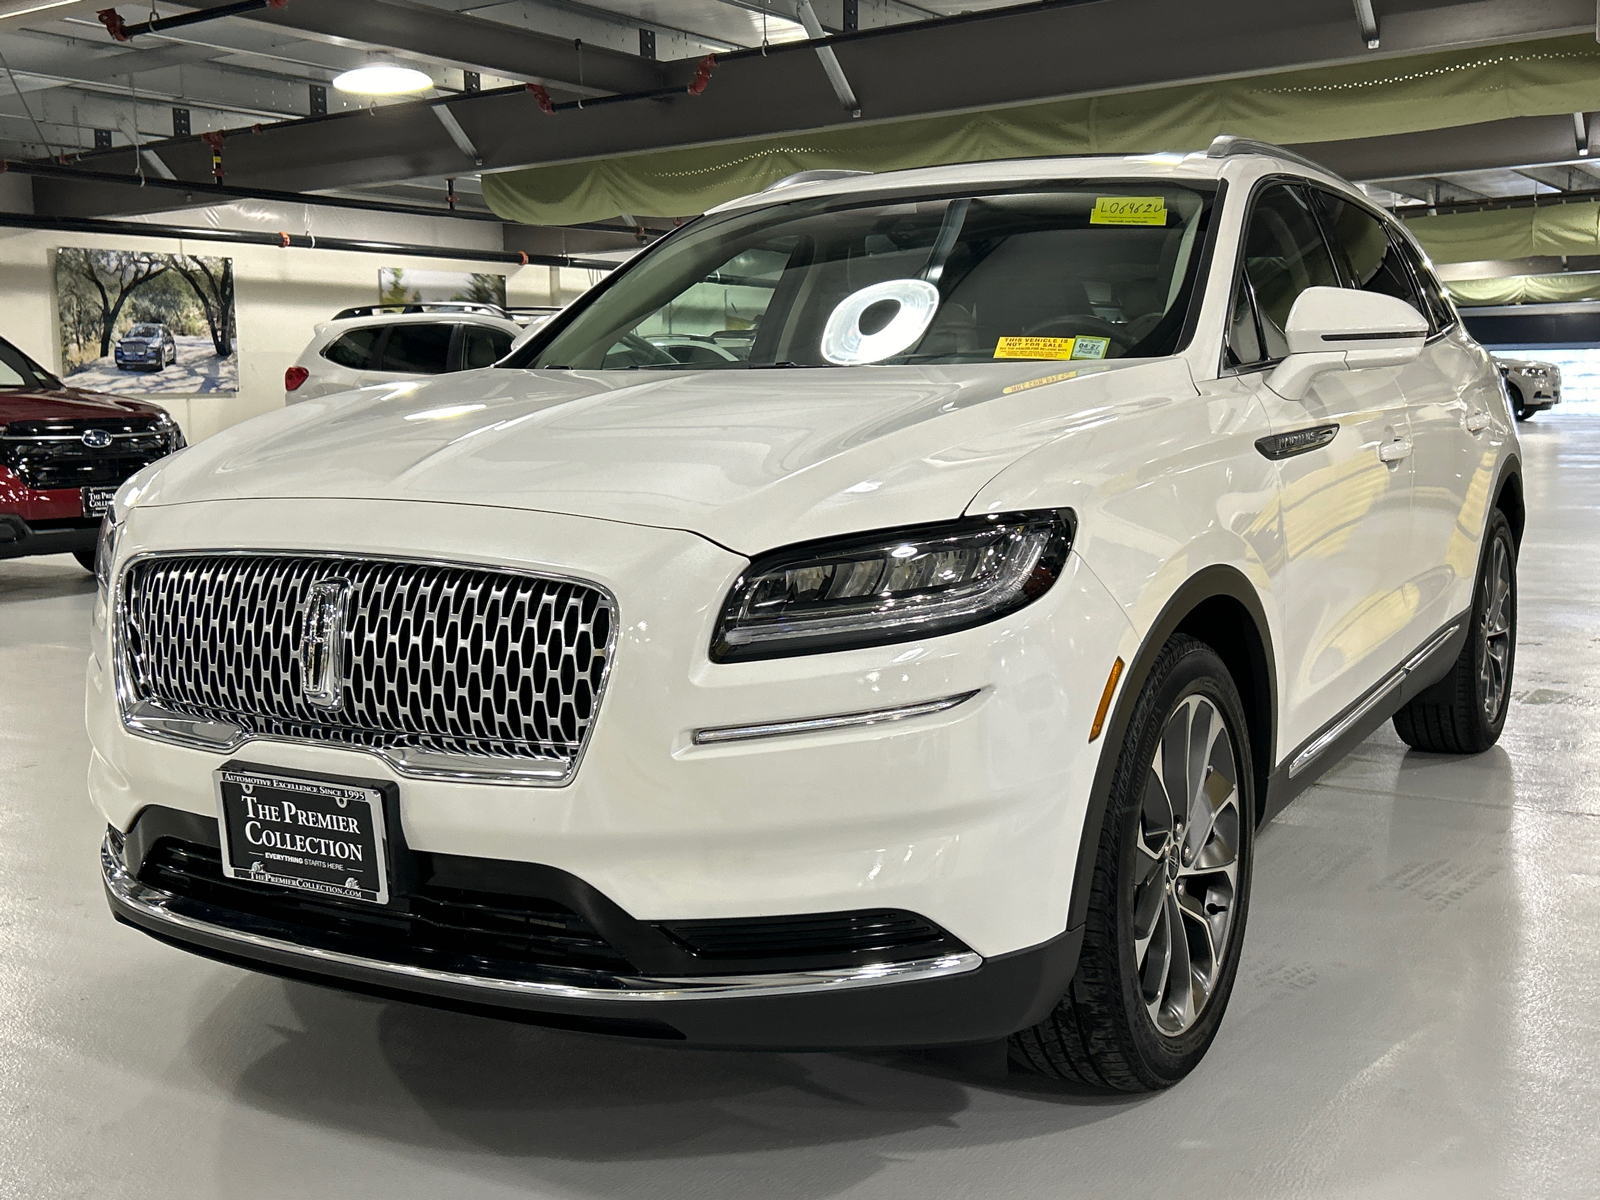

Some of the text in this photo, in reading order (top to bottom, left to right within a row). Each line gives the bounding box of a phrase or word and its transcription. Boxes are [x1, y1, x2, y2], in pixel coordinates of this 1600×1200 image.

[225, 772, 364, 800] AUTOMOTIVE EXCELLENCE SINCE 1995
[241, 795, 361, 834] THE PREMIER
[245, 820, 362, 862] COLLECTION
[265, 851, 304, 864] EVERYTHING
[304, 858, 327, 869] STARTS
